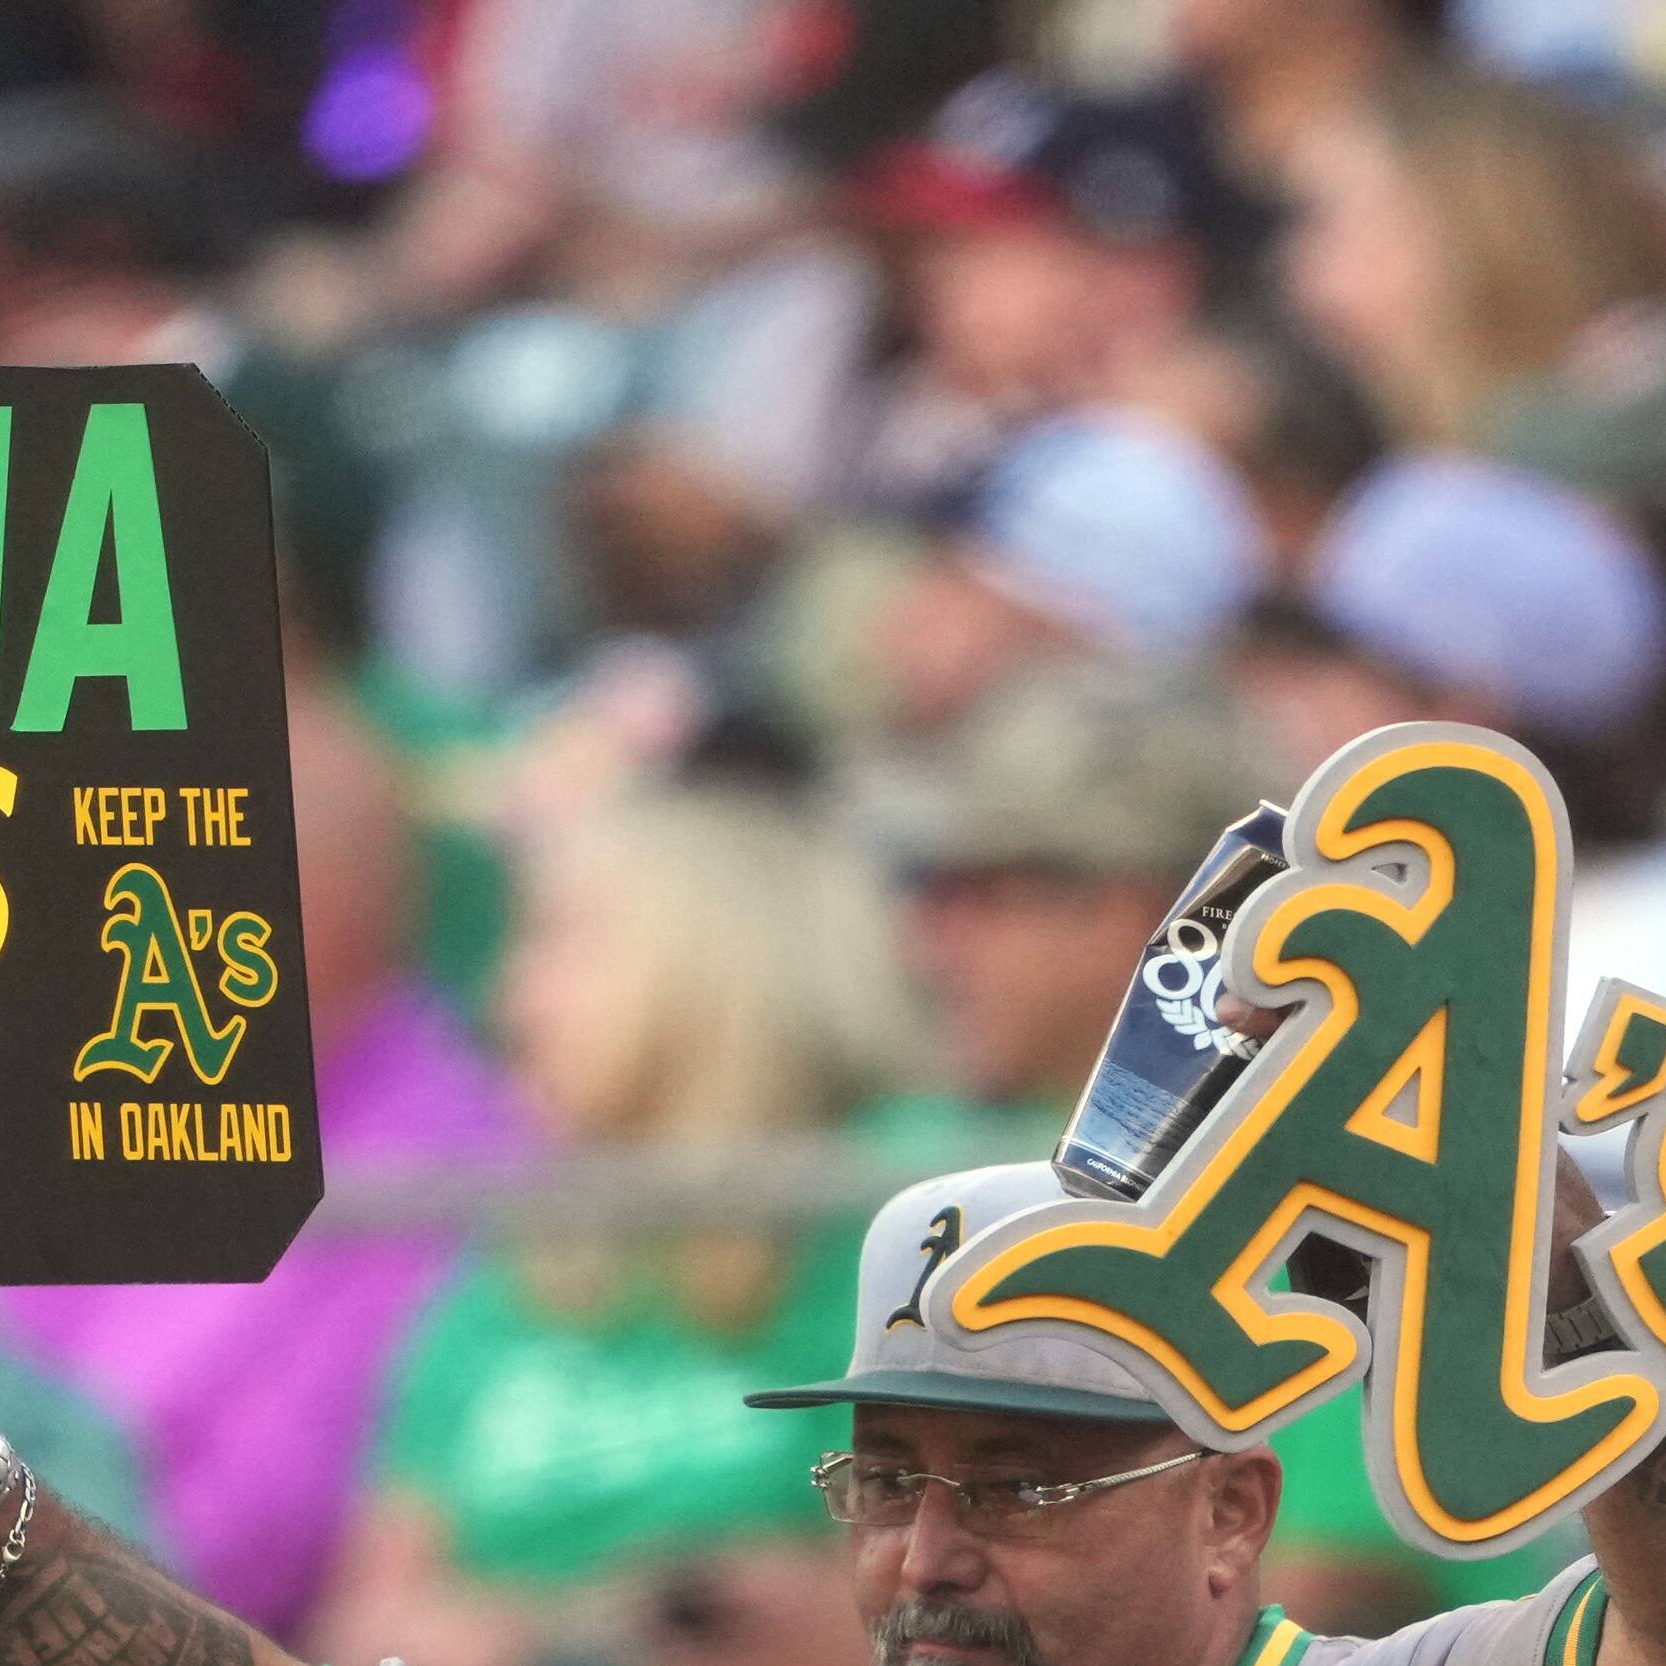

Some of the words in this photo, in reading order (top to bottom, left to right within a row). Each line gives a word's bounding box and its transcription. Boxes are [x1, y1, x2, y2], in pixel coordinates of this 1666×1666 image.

[74, 787, 167, 846] KEEP
[180, 788, 252, 847] THE
[73, 863, 279, 1086] A's
[69, 1102, 105, 1161] IN
[119, 1102, 293, 1163] OAKLAND
